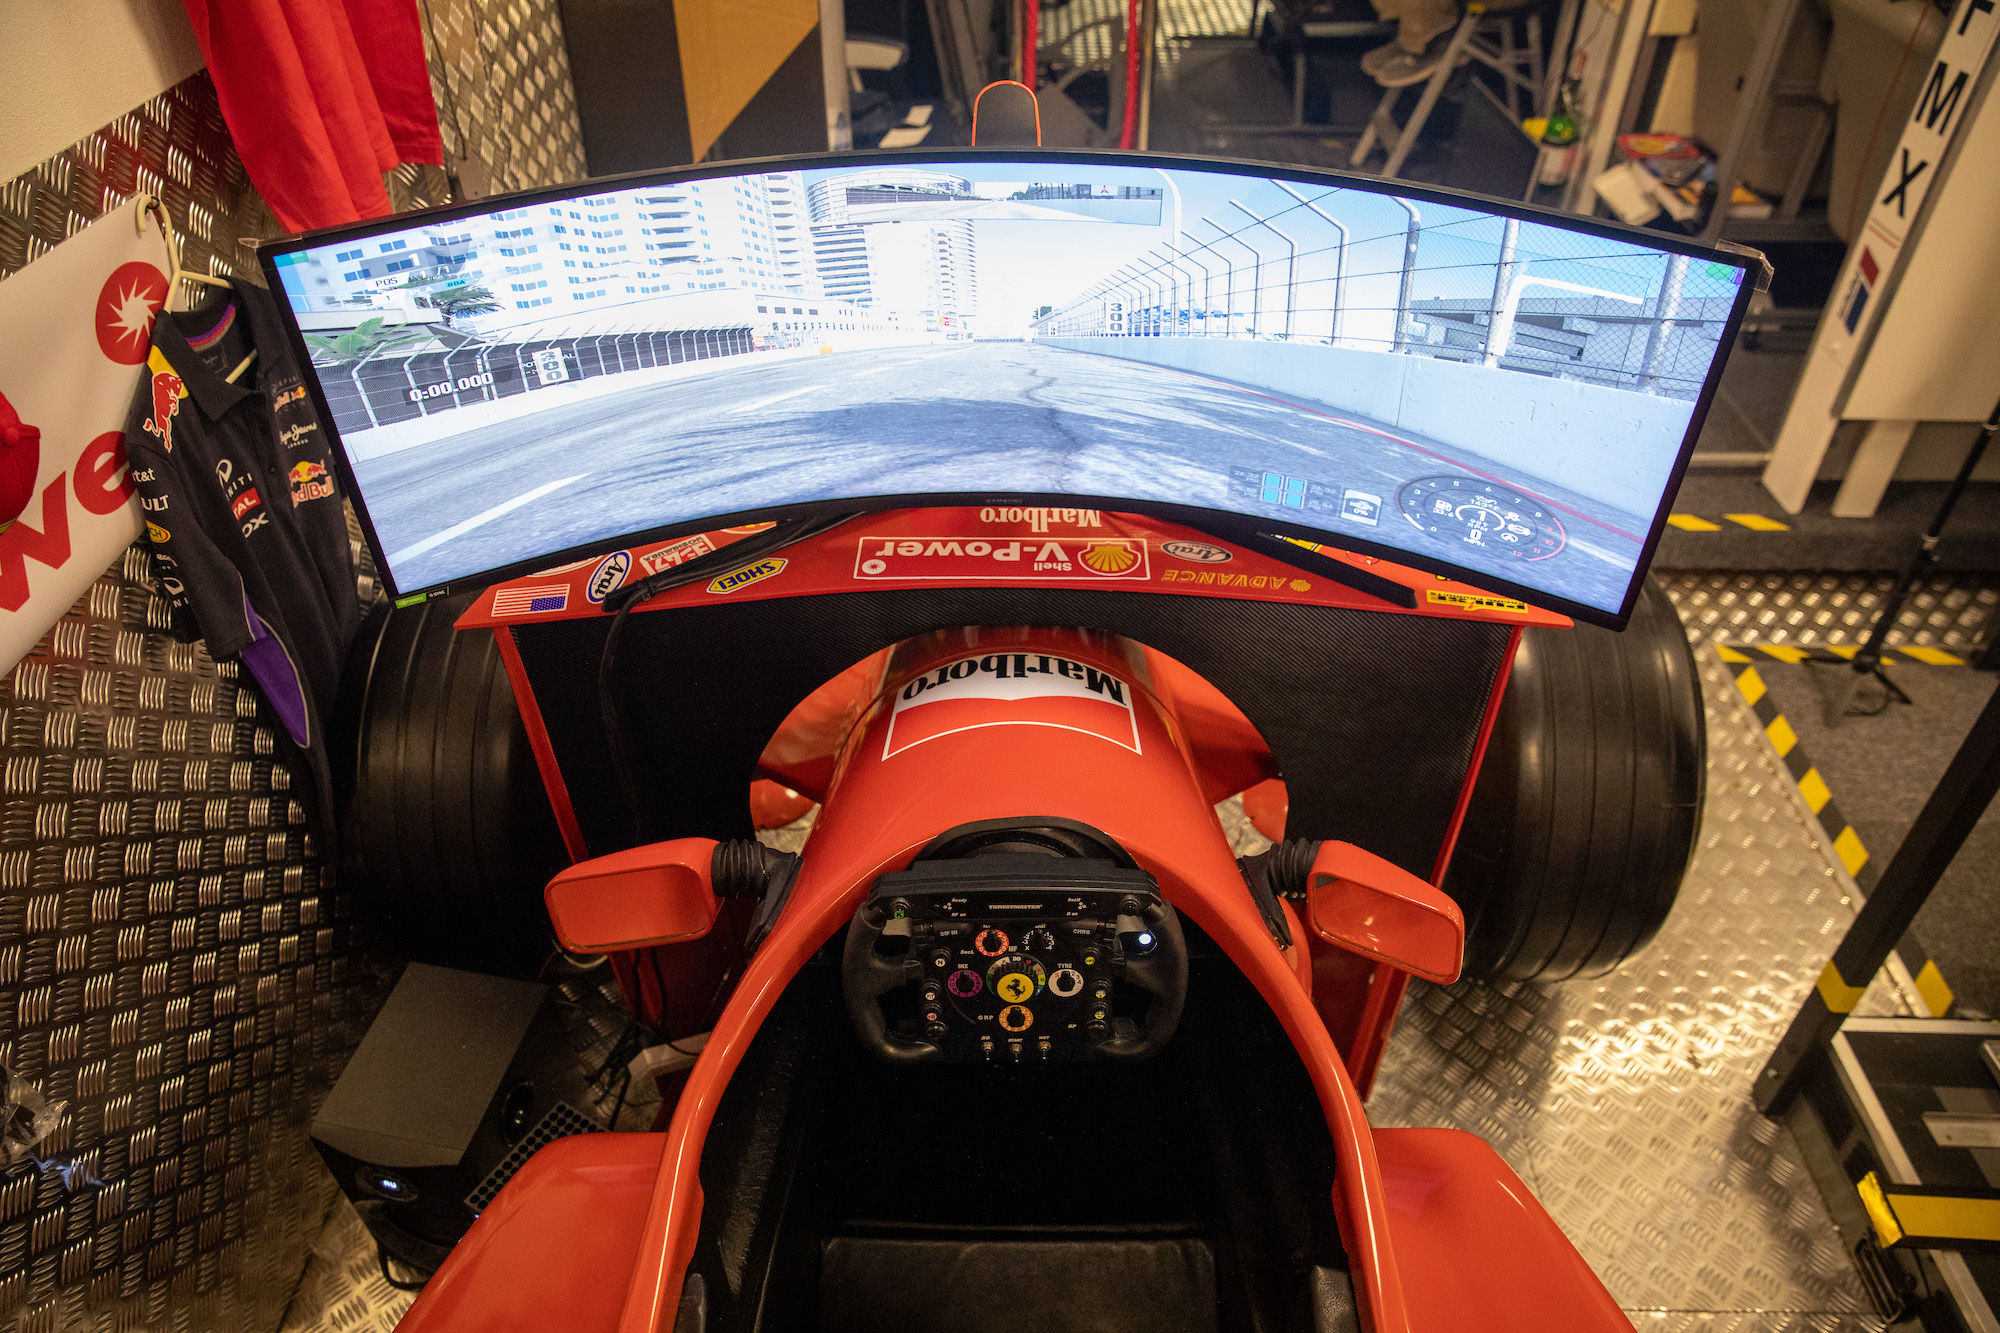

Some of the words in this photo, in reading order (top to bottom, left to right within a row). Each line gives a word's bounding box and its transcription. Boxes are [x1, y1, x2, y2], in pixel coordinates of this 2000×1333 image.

[375, 277, 398, 288] POS
[1109, 302, 1123, 332] 300
[409, 373, 494, 402] 0:00.000
[980, 507, 1102, 533] Marlboro
[1477, 510, 1486, 522] 1
[1463, 537, 1486, 548] MPH
[1469, 528, 1482, 540] 0
[643, 536, 704, 562] YOSHIMURA
[875, 541, 1070, 562] V-Power
[1172, 544, 1226, 560] Arai
[717, 561, 776, 590] SHOEI
[1033, 562, 1073, 572] Shell
[1161, 569, 1287, 590] ADVANCE
[902, 653, 1127, 706] Marlboro
